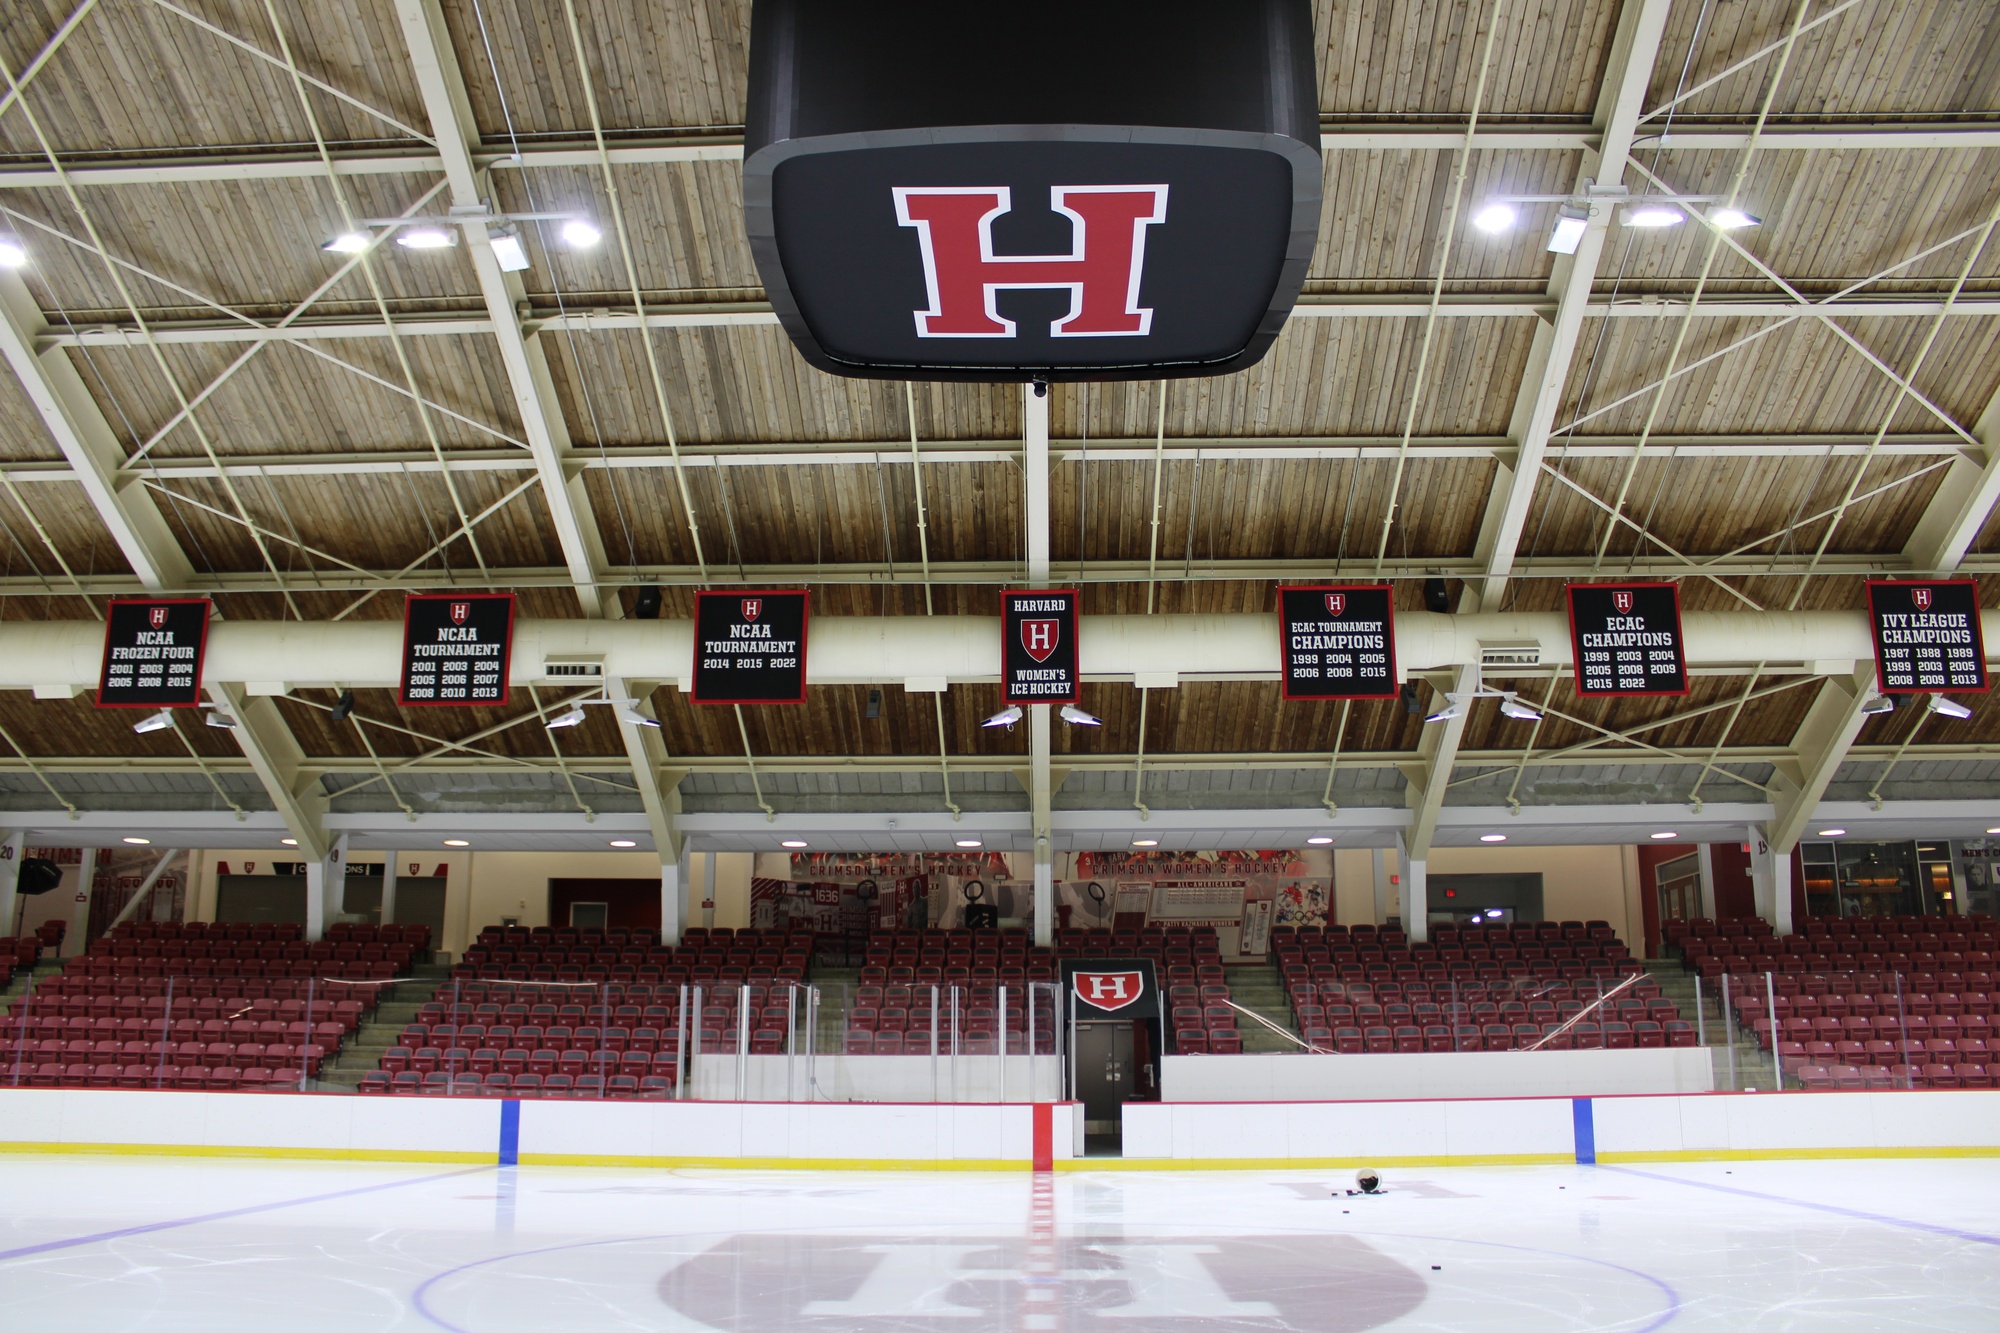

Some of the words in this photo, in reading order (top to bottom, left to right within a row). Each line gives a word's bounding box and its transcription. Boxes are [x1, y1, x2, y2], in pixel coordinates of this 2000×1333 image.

[891, 184, 1169, 338] H
[1330, 596, 1341, 610] H
[1618, 594, 1629, 608] H
[1916, 591, 1928, 605] H
[454, 605, 466, 619] H
[746, 601, 757, 615] H
[1014, 600, 1066, 612] HARVARD
[153, 610, 164, 623] H
[1882, 614, 1907, 627] IVY
[1910, 614, 1967, 627] LEAGUE
[1292, 622, 1315, 633] ECAC
[1318, 622, 1382, 632] TOURNAMENT
[1606, 617, 1645, 630] ECAC
[437, 628, 477, 641] NCAA
[730, 624, 771, 638] NCAA
[1031, 624, 1049, 649] H
[1882, 630, 1971, 643] CHAMPIONS
[136, 632, 174, 645] NCAA
[1292, 635, 1384, 649] CHAMPIONS
[1583, 633, 1672, 647] CHAMPIONS
[112, 647, 160, 659] FROZEN
[162, 647, 194, 659] FOUR
[414, 644, 500, 656] TOURNAMENT
[705, 641, 796, 653] TOURNAMENT
[1884, 649, 1909, 658] 1987
[1916, 649, 1941, 658] 1988
[1947, 648, 1973, 658] 1989
[1293, 655, 1318, 664] 1999
[1326, 654, 1352, 664] 2004
[1360, 654, 1385, 663] 2005
[1584, 652, 1610, 662] 1999
[1617, 652, 1642, 661] 2003
[1649, 651, 1675, 660] 2004
[110, 664, 134, 674] 2001
[139, 664, 163, 674] 2003
[169, 664, 193, 673] 2004
[412, 662, 436, 672] 2001
[443, 662, 468, 671] 2003
[474, 661, 499, 671] 2004
[704, 659, 729, 669] 2014
[737, 659, 762, 668] 2015
[770, 658, 796, 668] 2022
[1886, 662, 1911, 671] 1999
[1918, 662, 1943, 671] 2003
[1949, 662, 1975, 671] 2005
[1016, 669, 1066, 681] WOMEN'S
[1293, 668, 1319, 678] 2006
[1327, 668, 1353, 677] 2008
[1361, 668, 1386, 677] 2015
[1586, 666, 1611, 675] 2005
[1618, 665, 1644, 675] 2008
[1651, 665, 1676, 674] 2009
[108, 678, 132, 687] 2005
[138, 678, 162, 687] 2008
[167, 677, 192, 687] 2015
[410, 675, 435, 685] 2005
[442, 675, 467, 684] 2006
[473, 675, 498, 684] 2007
[1587, 679, 1612, 688] 2015
[1620, 679, 1645, 688] 2022
[1888, 675, 1913, 685] 2008
[1920, 675, 1945, 684] 2009
[1951, 675, 1977, 684] 2013
[409, 688, 434, 698] 2008
[441, 688, 466, 698] 2010
[472, 688, 497, 697] 2013
[1011, 683, 1028, 695] ICE
[1030, 682, 1071, 694] HOCKEY
[0, 845, 13, 860] 20
[25, 848, 112, 864] RIMSN
[1961, 849, 1990, 857] MEN'S
[810, 866, 870, 876] CRIMSON
[880, 865, 920, 876] MEN'S
[929, 865, 981, 876] HOCKEY
[1093, 864, 1154, 874] CRIMSON
[1163, 863, 1227, 874] WOMEN'S
[1235, 863, 1287, 873] HOCKEY
[815, 889, 838, 903] 1636
[820, 914, 832, 931] H
[1090, 977, 1127, 998] H
